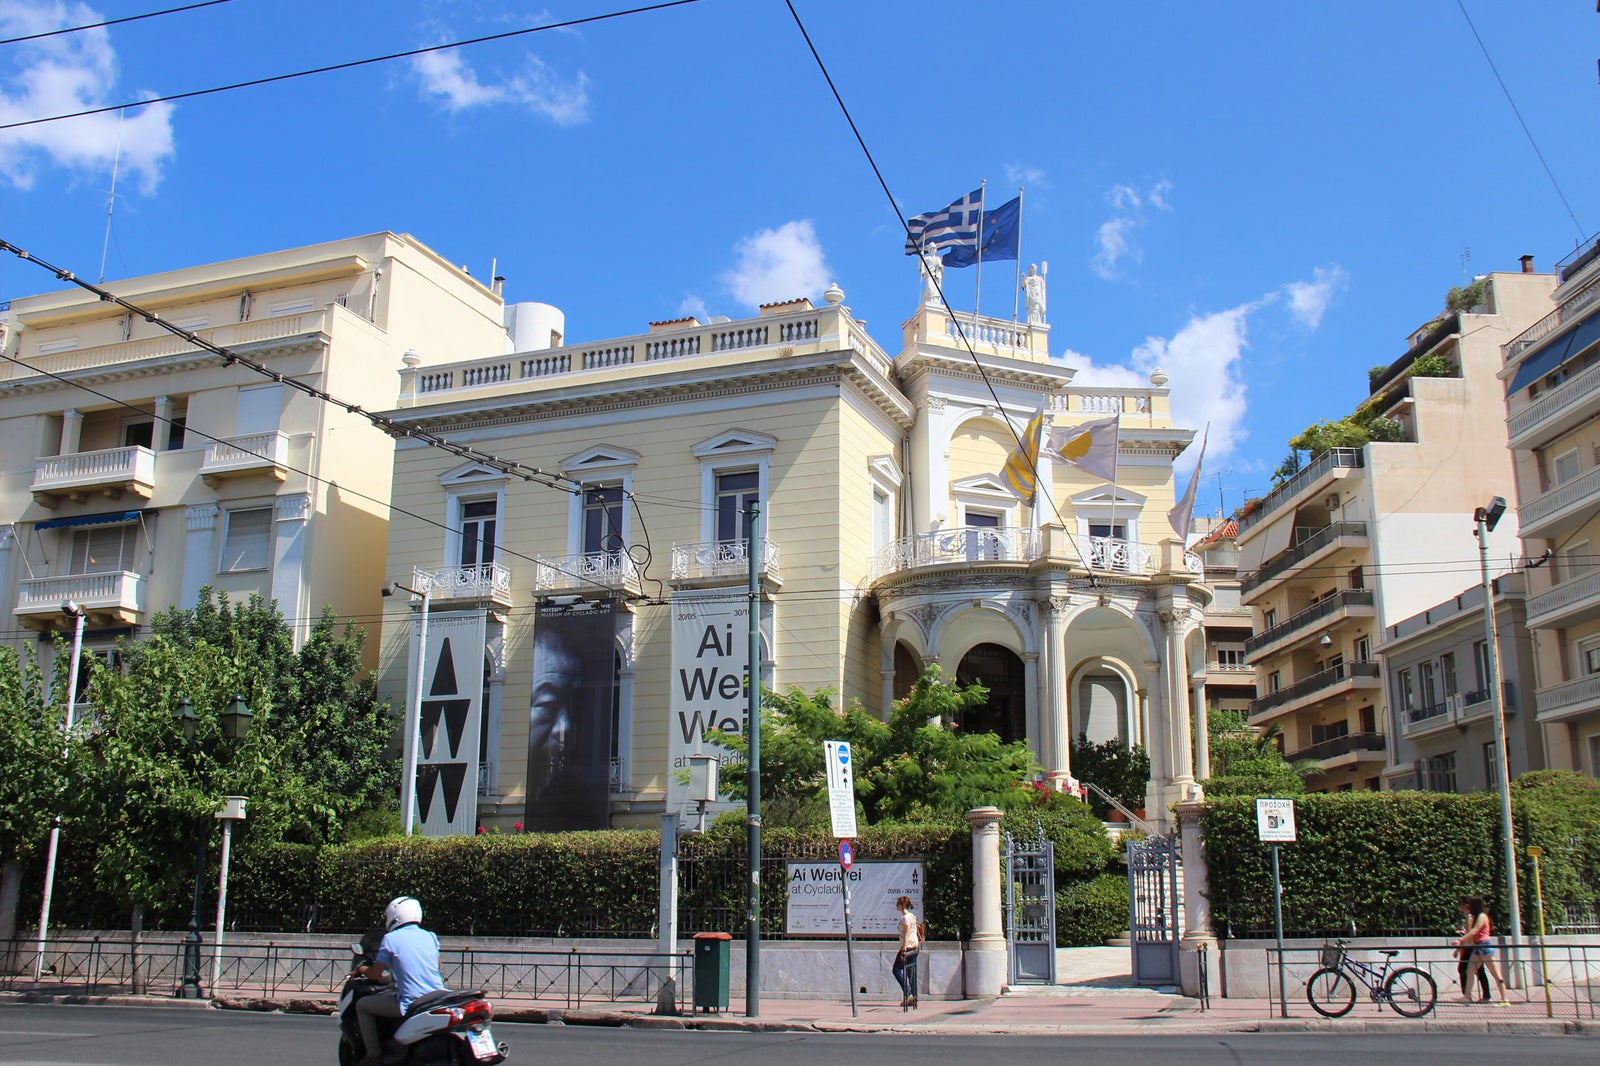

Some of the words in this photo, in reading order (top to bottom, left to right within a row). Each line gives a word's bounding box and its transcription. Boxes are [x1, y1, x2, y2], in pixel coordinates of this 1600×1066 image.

[678, 613, 697, 621] 20/05
[733, 609, 749, 617] 30/1
[696, 623, 733, 658] Ai
[679, 665, 750, 702] Wei
[674, 755, 687, 768] at
[792, 868, 806, 881] Ai
[791, 884, 801, 895] at
